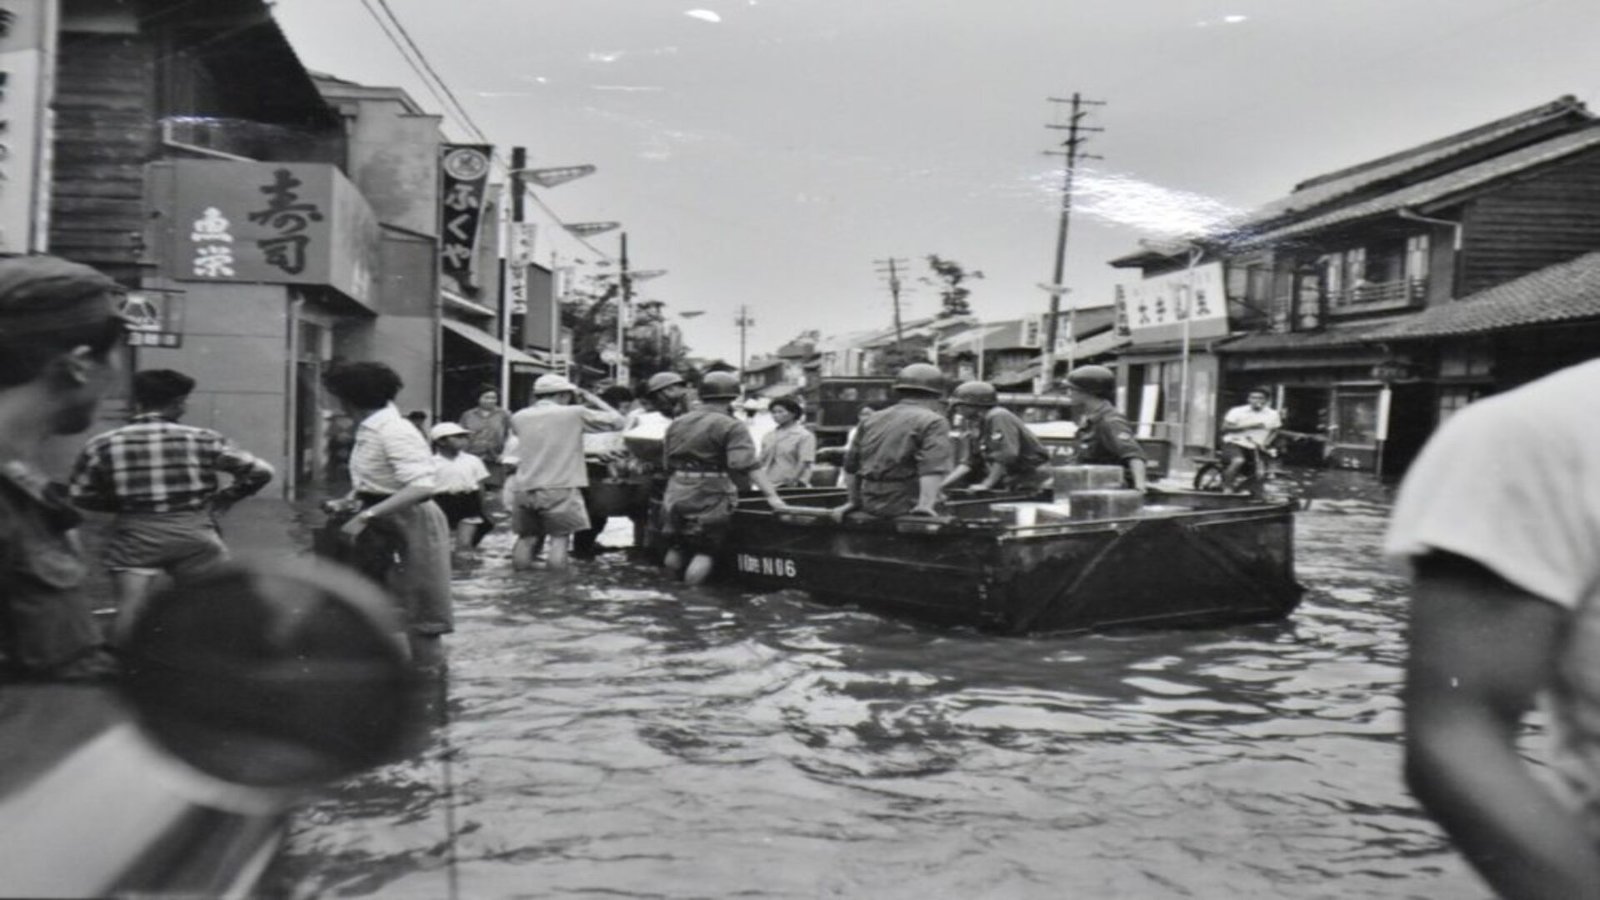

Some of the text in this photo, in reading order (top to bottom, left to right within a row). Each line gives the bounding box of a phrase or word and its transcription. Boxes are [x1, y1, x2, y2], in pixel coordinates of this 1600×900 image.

[248, 168, 323, 275] 寿司
[442, 183, 479, 269] ふくや
